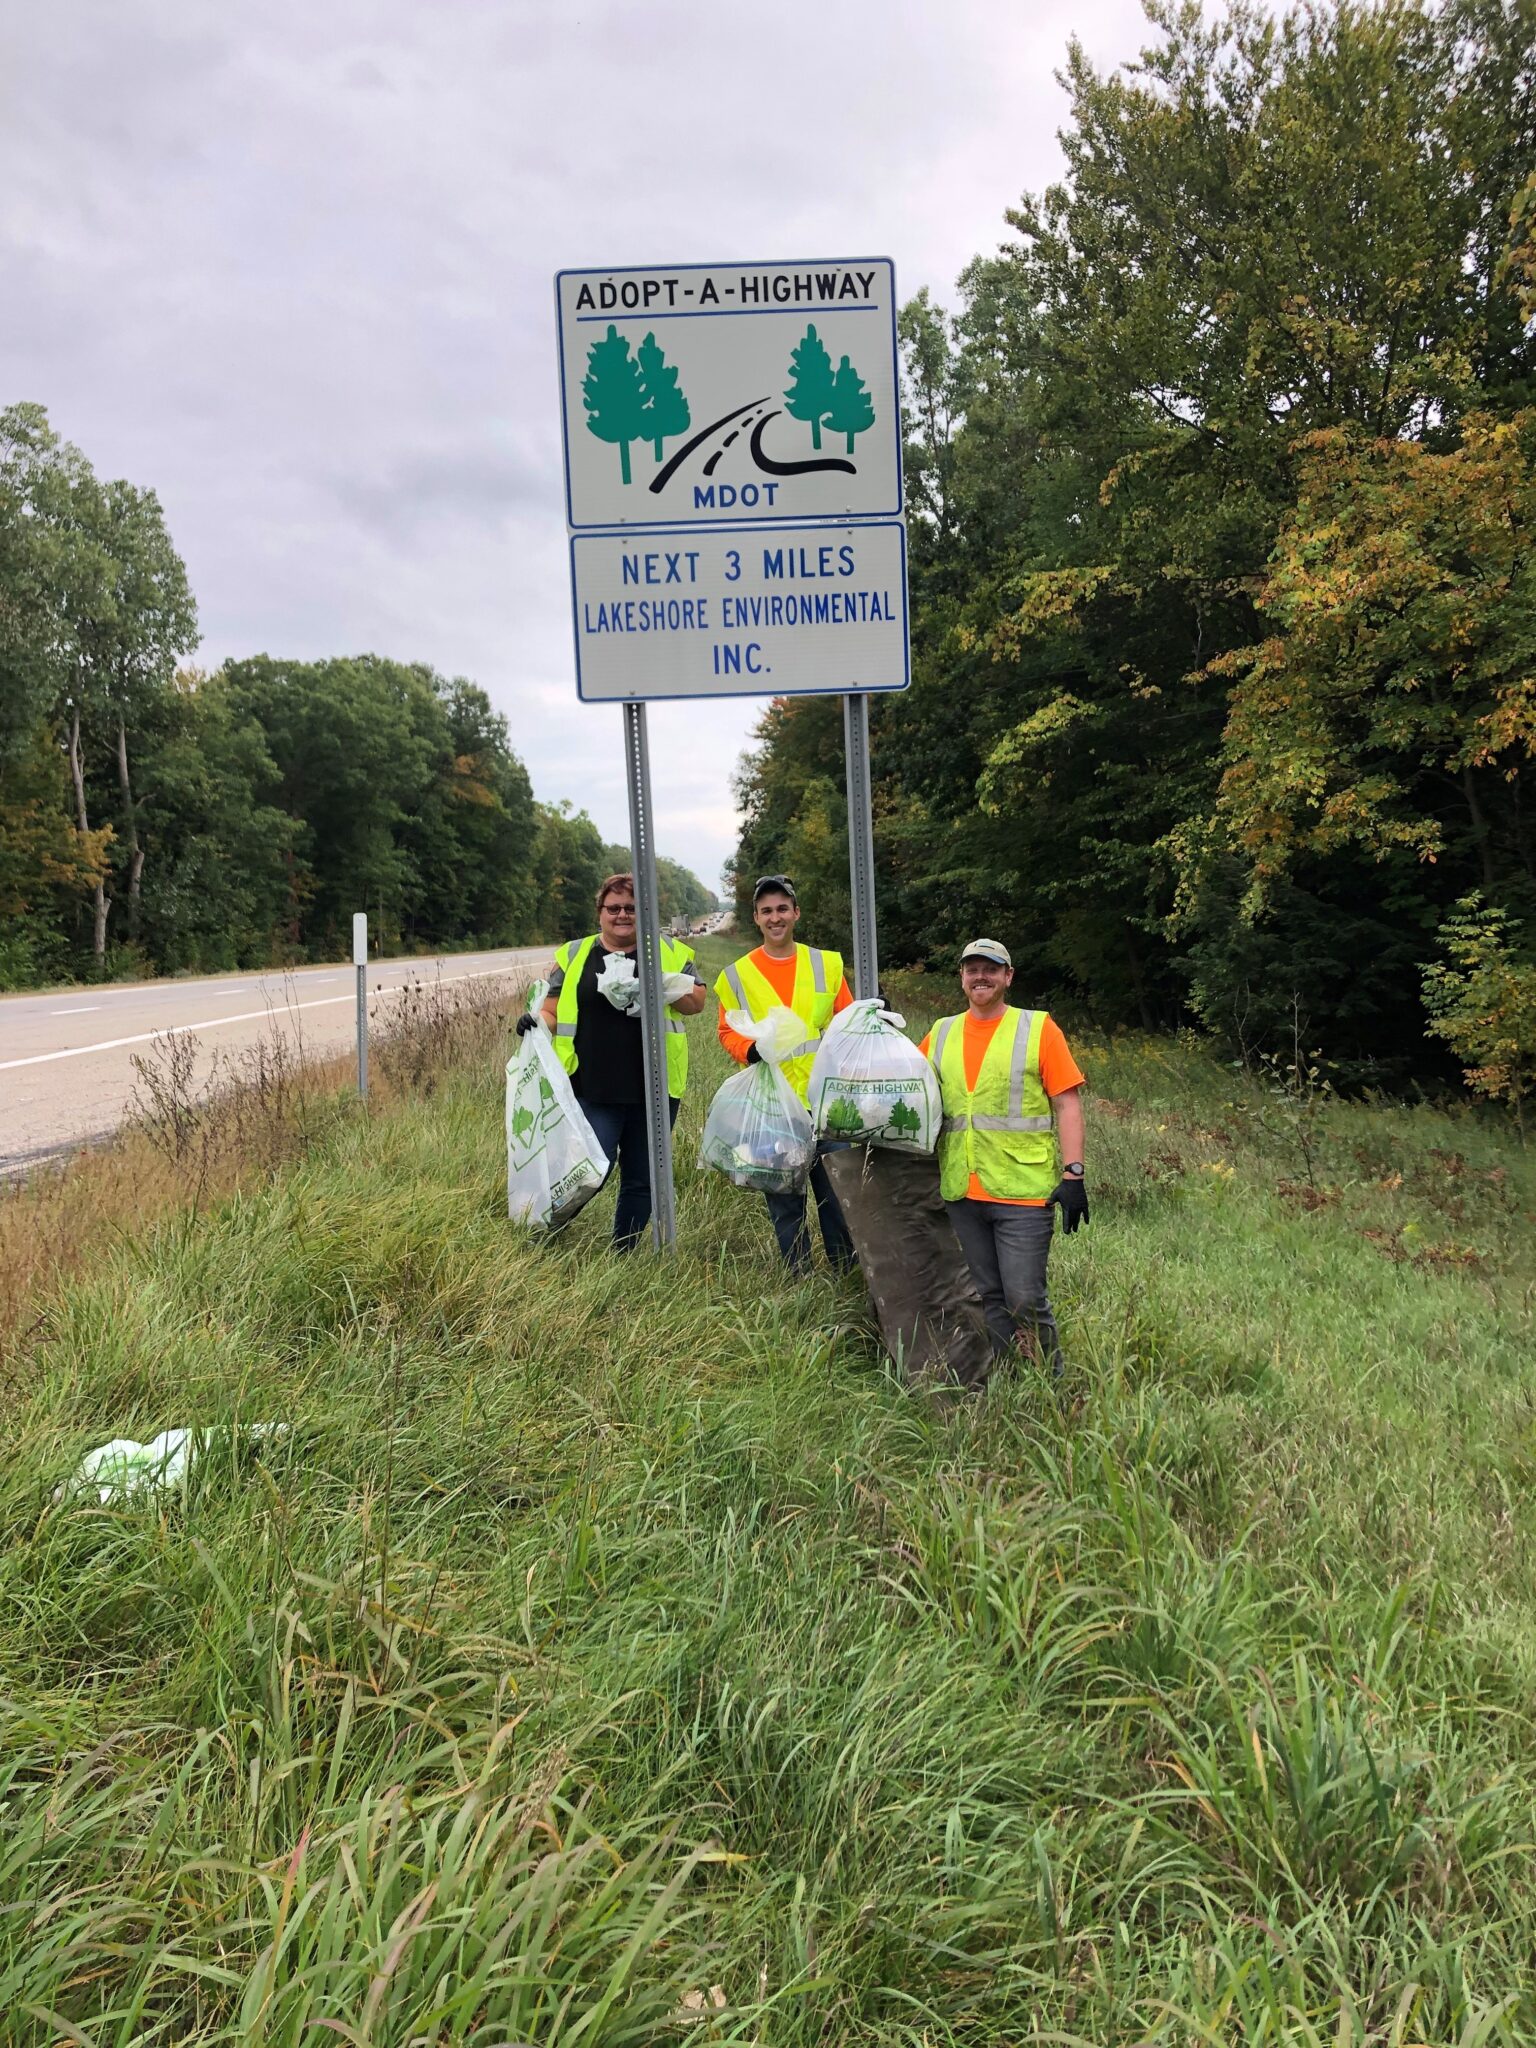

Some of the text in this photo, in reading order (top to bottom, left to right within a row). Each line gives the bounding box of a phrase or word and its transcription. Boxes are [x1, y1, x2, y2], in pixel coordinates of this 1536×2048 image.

[575, 271, 876, 311] ADOPT-A-HIGHWAY
[693, 482, 780, 509] MDOT
[622, 545, 855, 586] NEXT 3 MILES
[584, 590, 896, 634] LAKESHORE ENVIRONMENTAL
[713, 642, 772, 675] INC.
[827, 1081, 922, 1094] ADOPT-A-HIGHWA
